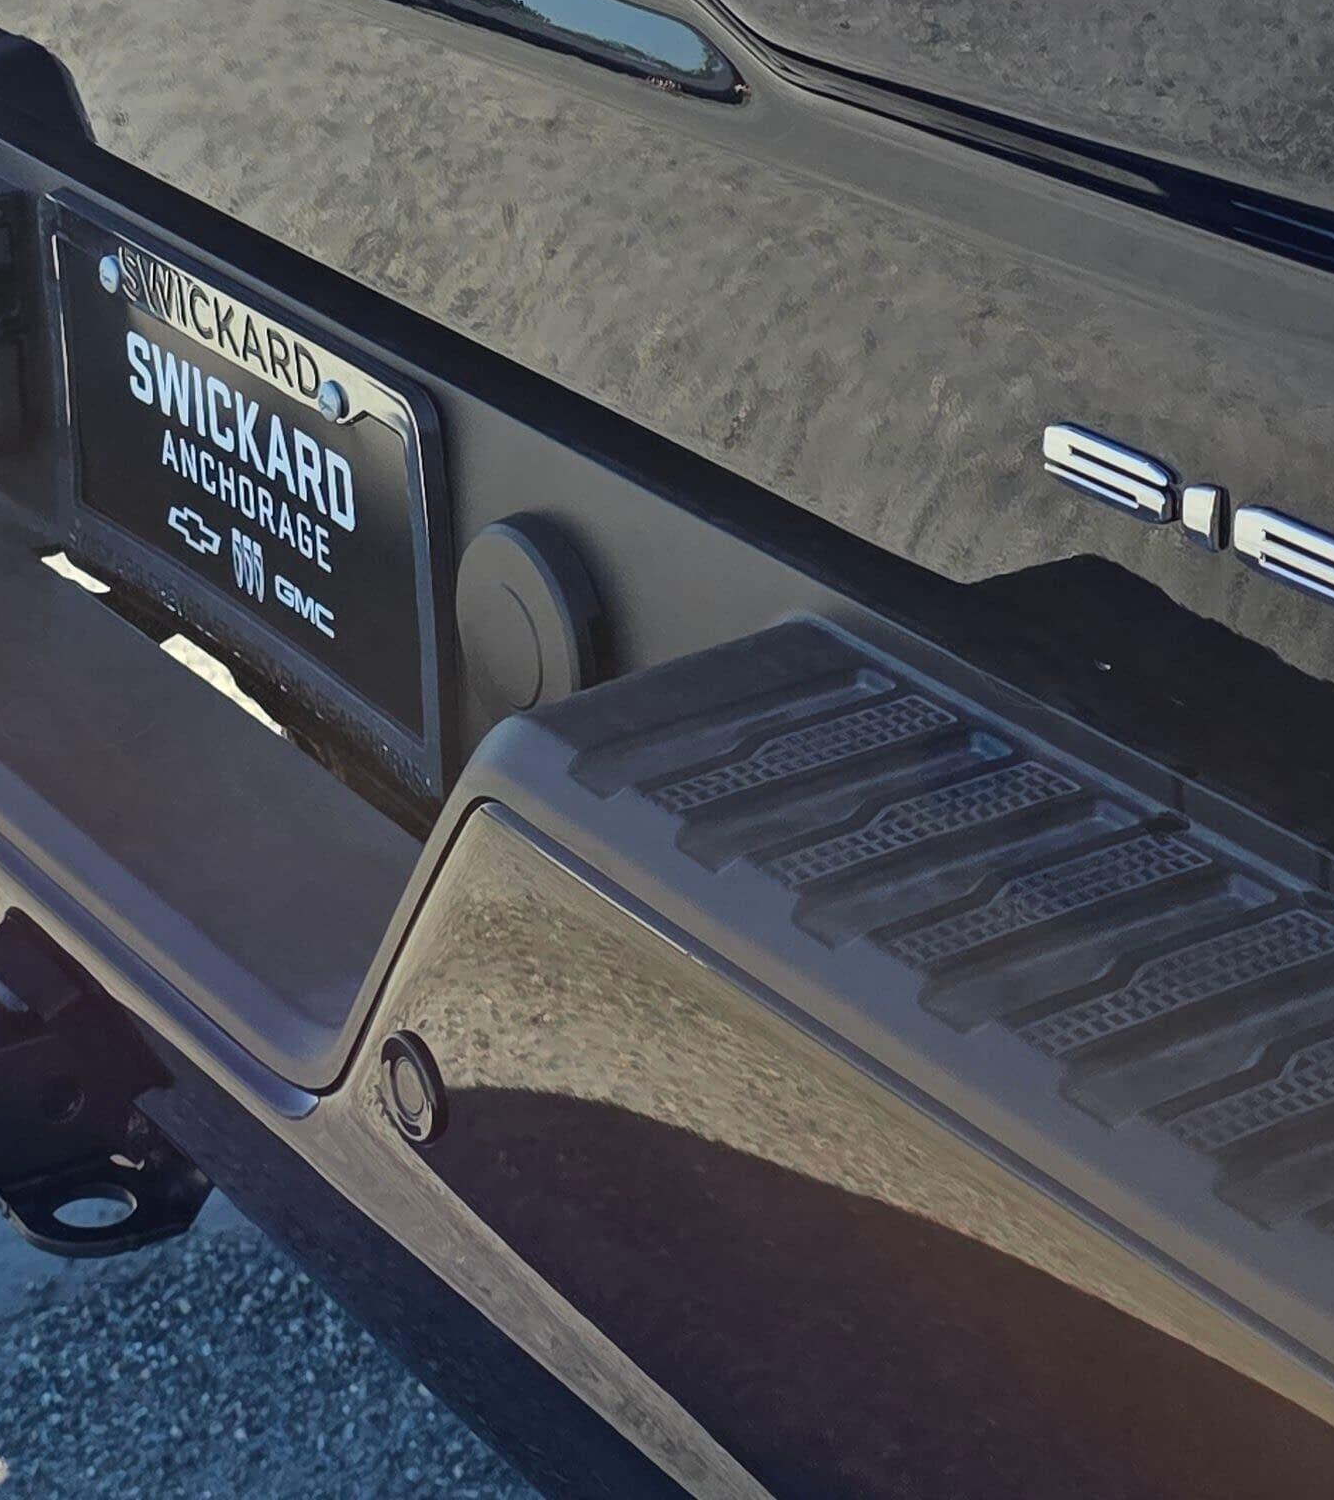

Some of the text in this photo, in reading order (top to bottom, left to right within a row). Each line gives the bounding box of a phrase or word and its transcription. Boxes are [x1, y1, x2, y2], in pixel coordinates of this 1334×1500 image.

[118, 246, 320, 400] SWICKARD
[126, 331, 356, 532] SWICKARD
[162, 429, 333, 573] ANCHORAGE
[275, 574, 335, 640] GMC
